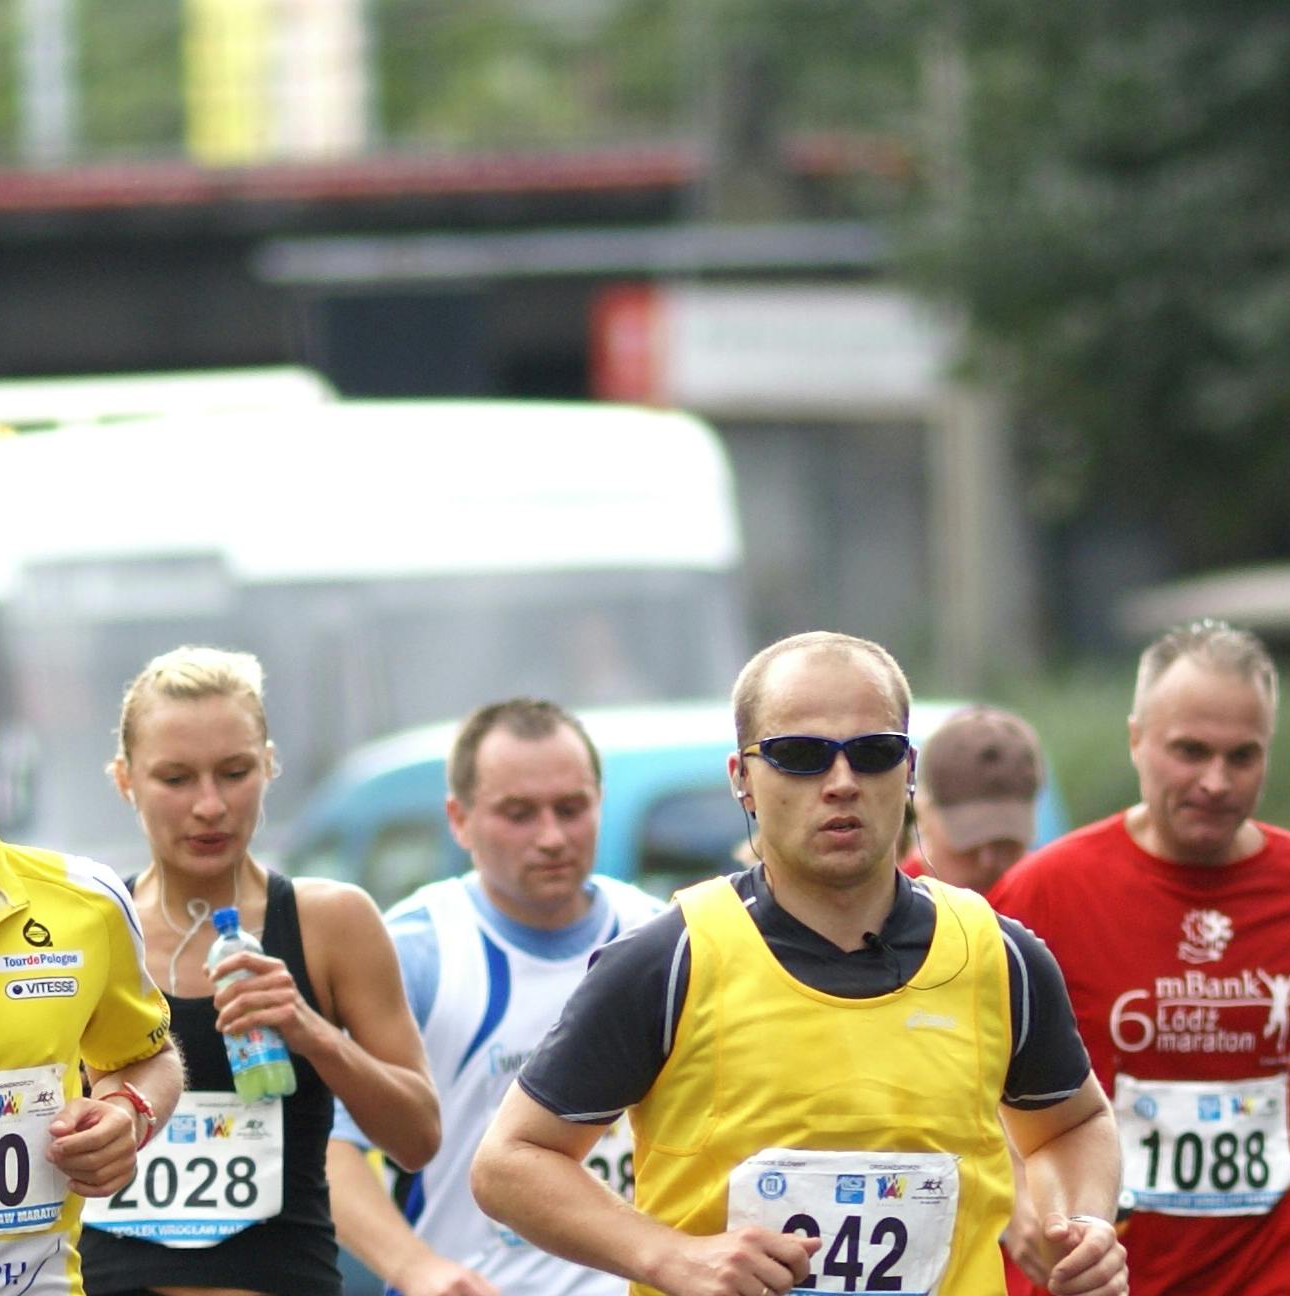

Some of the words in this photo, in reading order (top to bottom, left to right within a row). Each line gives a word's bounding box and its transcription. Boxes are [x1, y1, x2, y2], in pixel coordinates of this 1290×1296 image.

[26, 981, 75, 994] VITESSE
[1155, 971, 1263, 999] mBank
[1110, 988, 1155, 1052] 6
[1157, 1030, 1256, 1051] maraton
[1141, 1130, 1270, 1192] 1088
